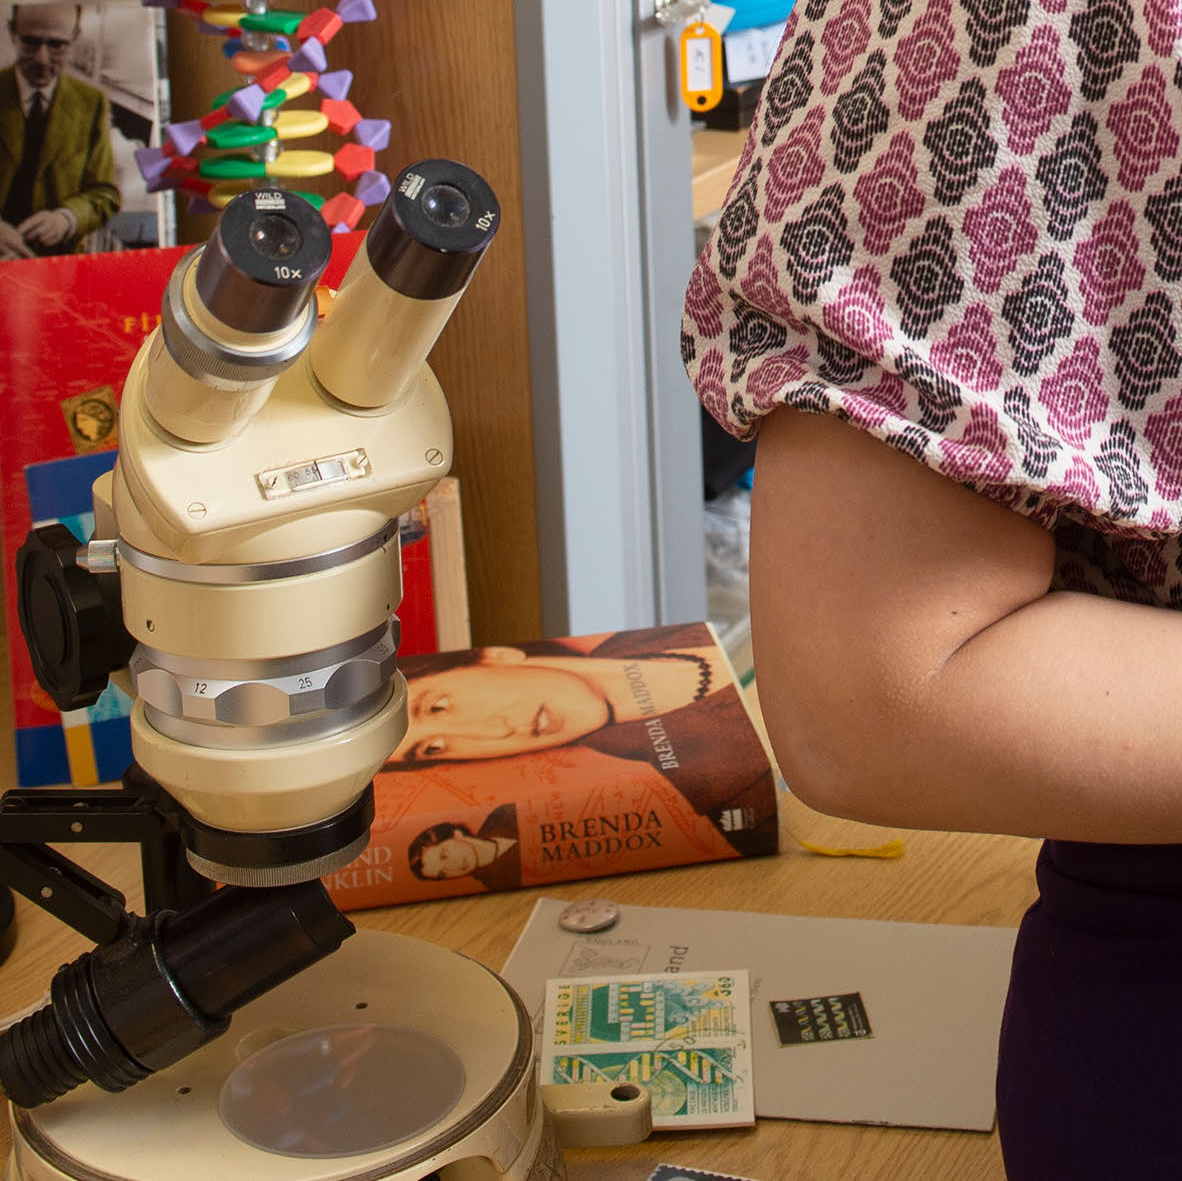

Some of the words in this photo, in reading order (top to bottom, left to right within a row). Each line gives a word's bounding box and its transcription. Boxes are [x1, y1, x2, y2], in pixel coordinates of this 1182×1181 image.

[399, 172, 415, 193] WILD
[254, 192, 282, 200] WILD
[474, 210, 497, 232] 10x
[274, 265, 302, 279] 10x
[193, 681, 208, 695] 12
[298, 676, 313, 690] 25
[623, 662, 657, 716] MADDOX
[644, 717, 680, 771] BRENDA
[539, 808, 664, 844] BRENDA
[540, 830, 664, 865] MADDOX
[554, 984, 571, 1047] SVERIGE
